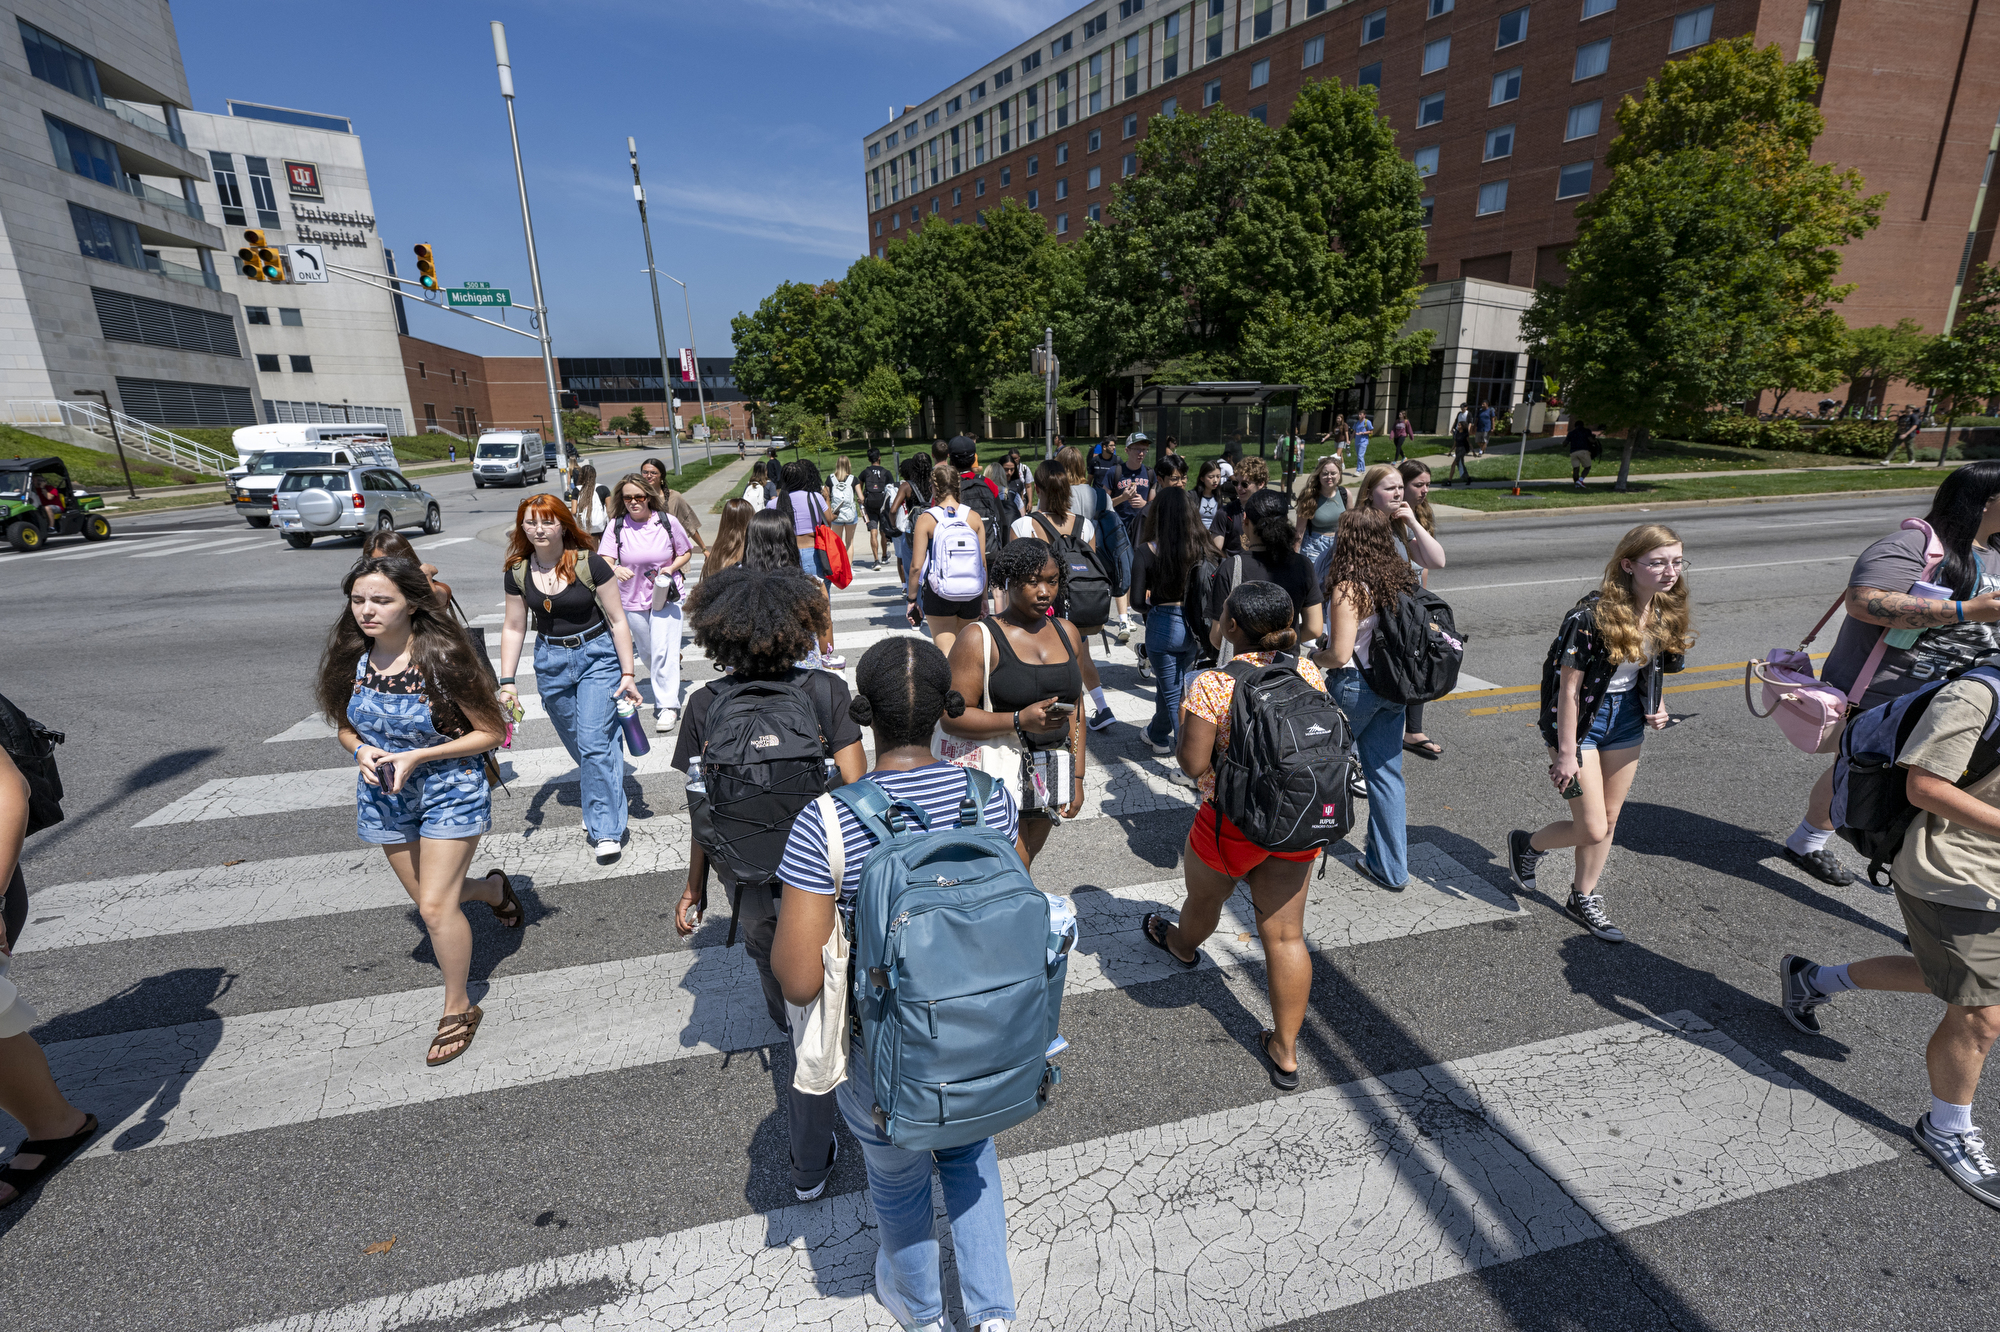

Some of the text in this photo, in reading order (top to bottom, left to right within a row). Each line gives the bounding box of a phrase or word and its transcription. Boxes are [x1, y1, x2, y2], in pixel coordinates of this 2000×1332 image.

[293, 185, 318, 193] HEALTH
[291, 203, 375, 233] University
[296, 224, 367, 250] Hospital
[299, 272, 322, 280] ONLY
[451, 292, 507, 305] Michigan St
[1134, 477, 1149, 487] SOX
